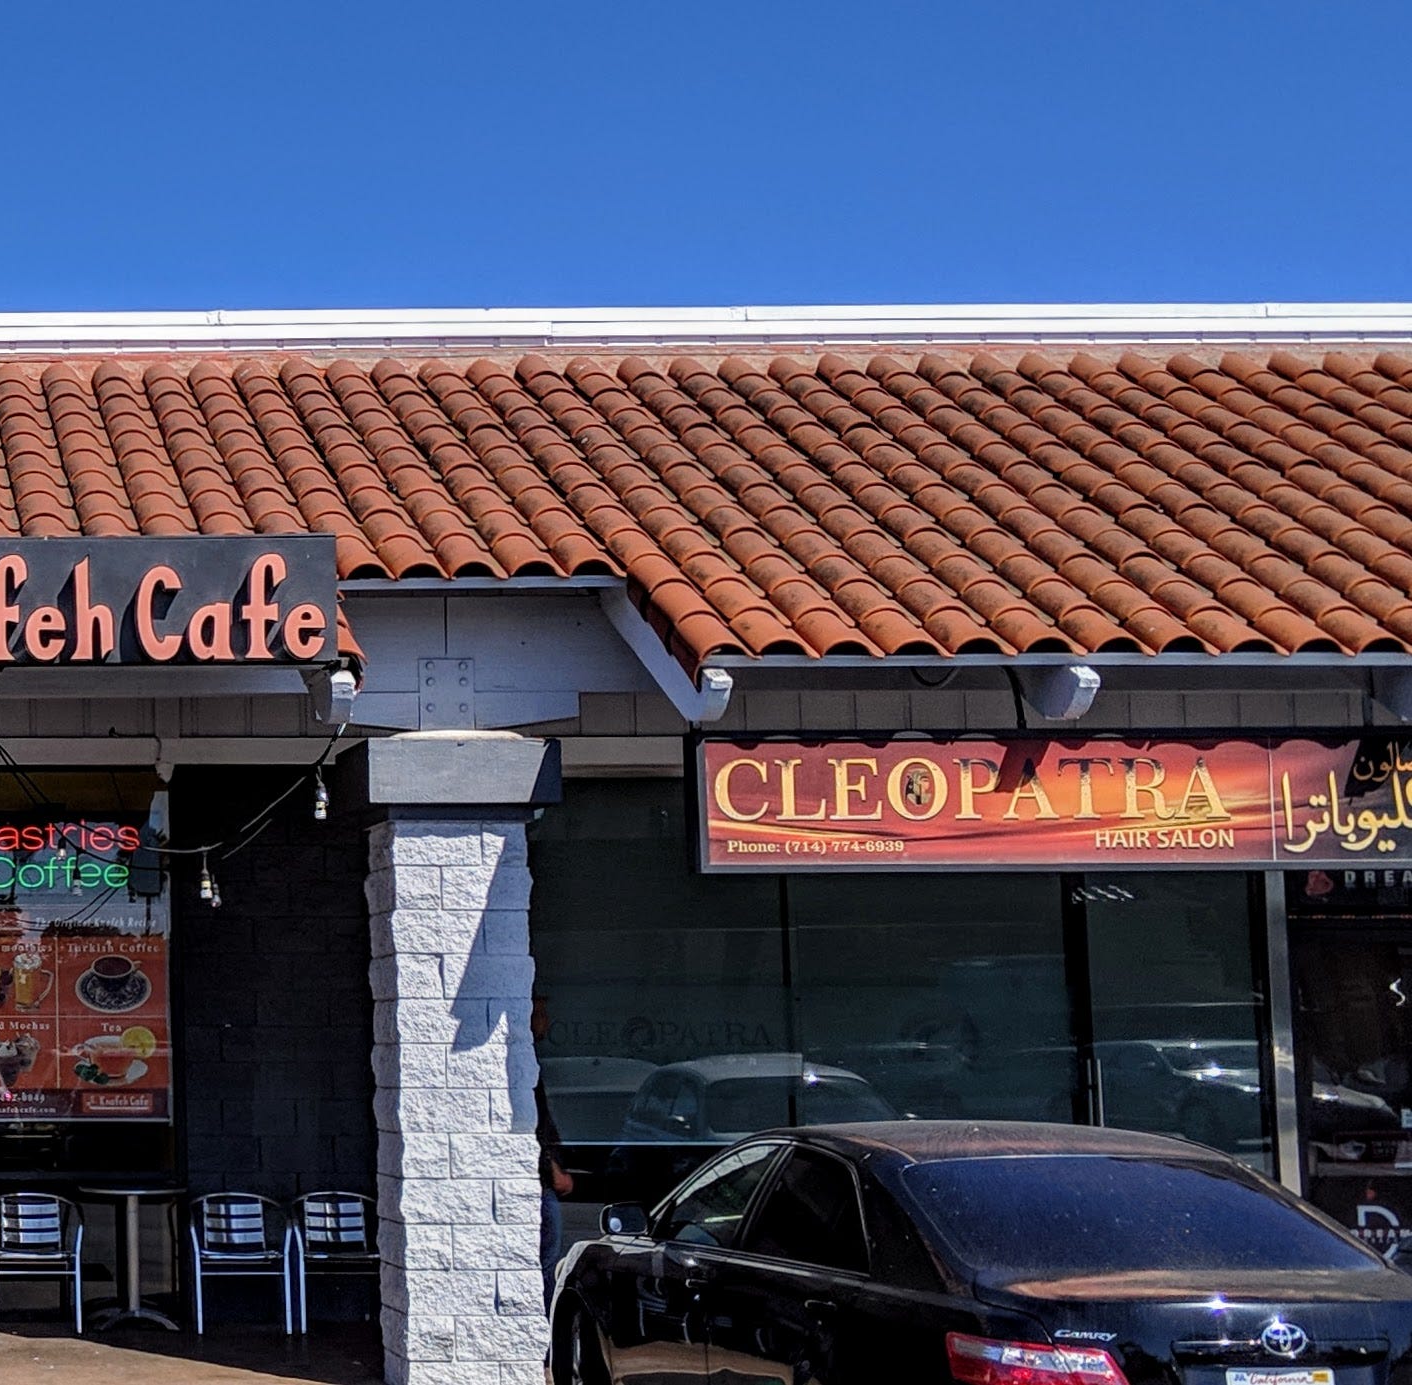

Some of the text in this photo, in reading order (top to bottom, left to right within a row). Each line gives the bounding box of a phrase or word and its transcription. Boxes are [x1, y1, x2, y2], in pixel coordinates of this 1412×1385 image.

[134, 553, 326, 662] Cafe
[714, 757, 1232, 821] CLEOPATRA
[1095, 829, 1235, 849] HAIR SALON
[727, 840, 905, 856] Phone: (714) 774-6939
[67, 943, 159, 953] Turkish Coffee
[9, 1021, 50, 1031] Mochas
[101, 1022, 123, 1032] Tea
